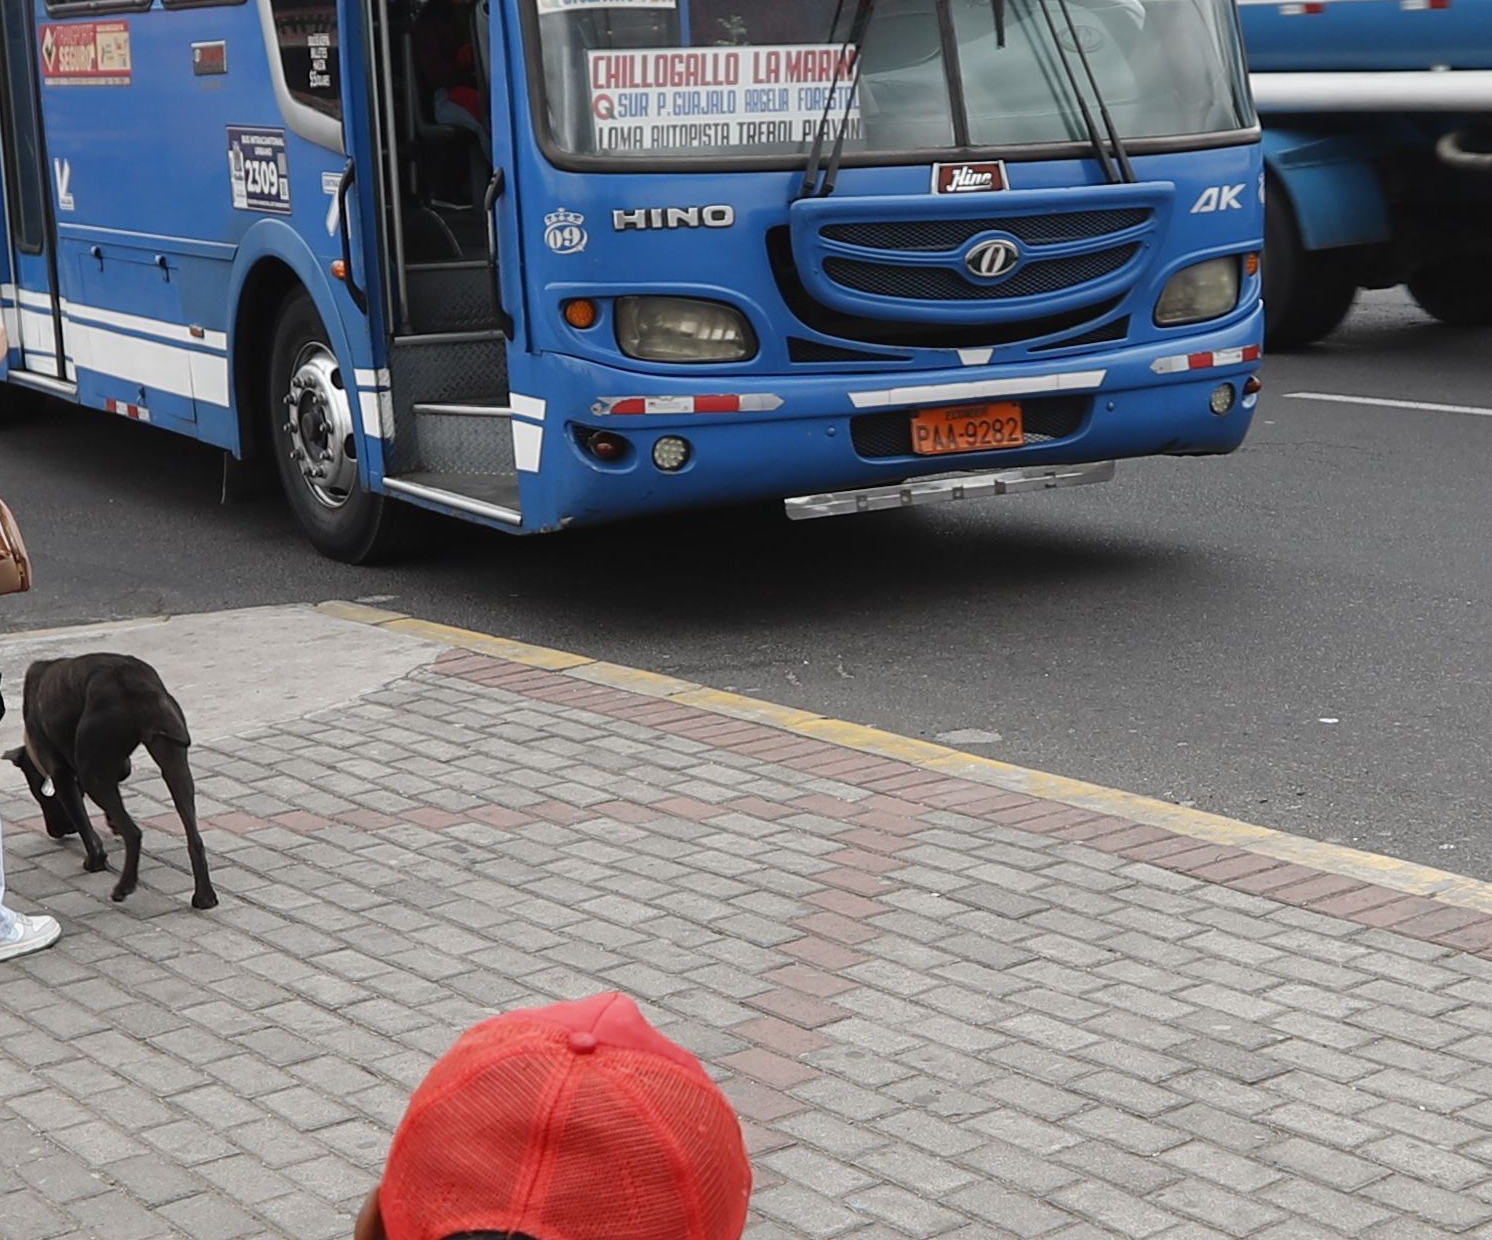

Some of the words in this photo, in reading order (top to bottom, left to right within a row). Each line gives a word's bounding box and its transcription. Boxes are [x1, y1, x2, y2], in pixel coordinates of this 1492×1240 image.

[592, 53, 740, 89] CHILLOGALLO
[753, 51, 781, 84] LA
[745, 87, 789, 113] ARGELIA
[598, 126, 644, 151] LOMA
[651, 121, 730, 148] AUTOPISTA
[737, 120, 793, 145] TREBOL
[245, 159, 278, 195] 2309
[946, 166, 993, 191] Hino
[1190, 183, 1246, 214] AK
[612, 205, 735, 231] HINO
[916, 417, 1020, 452] PAA-9282
